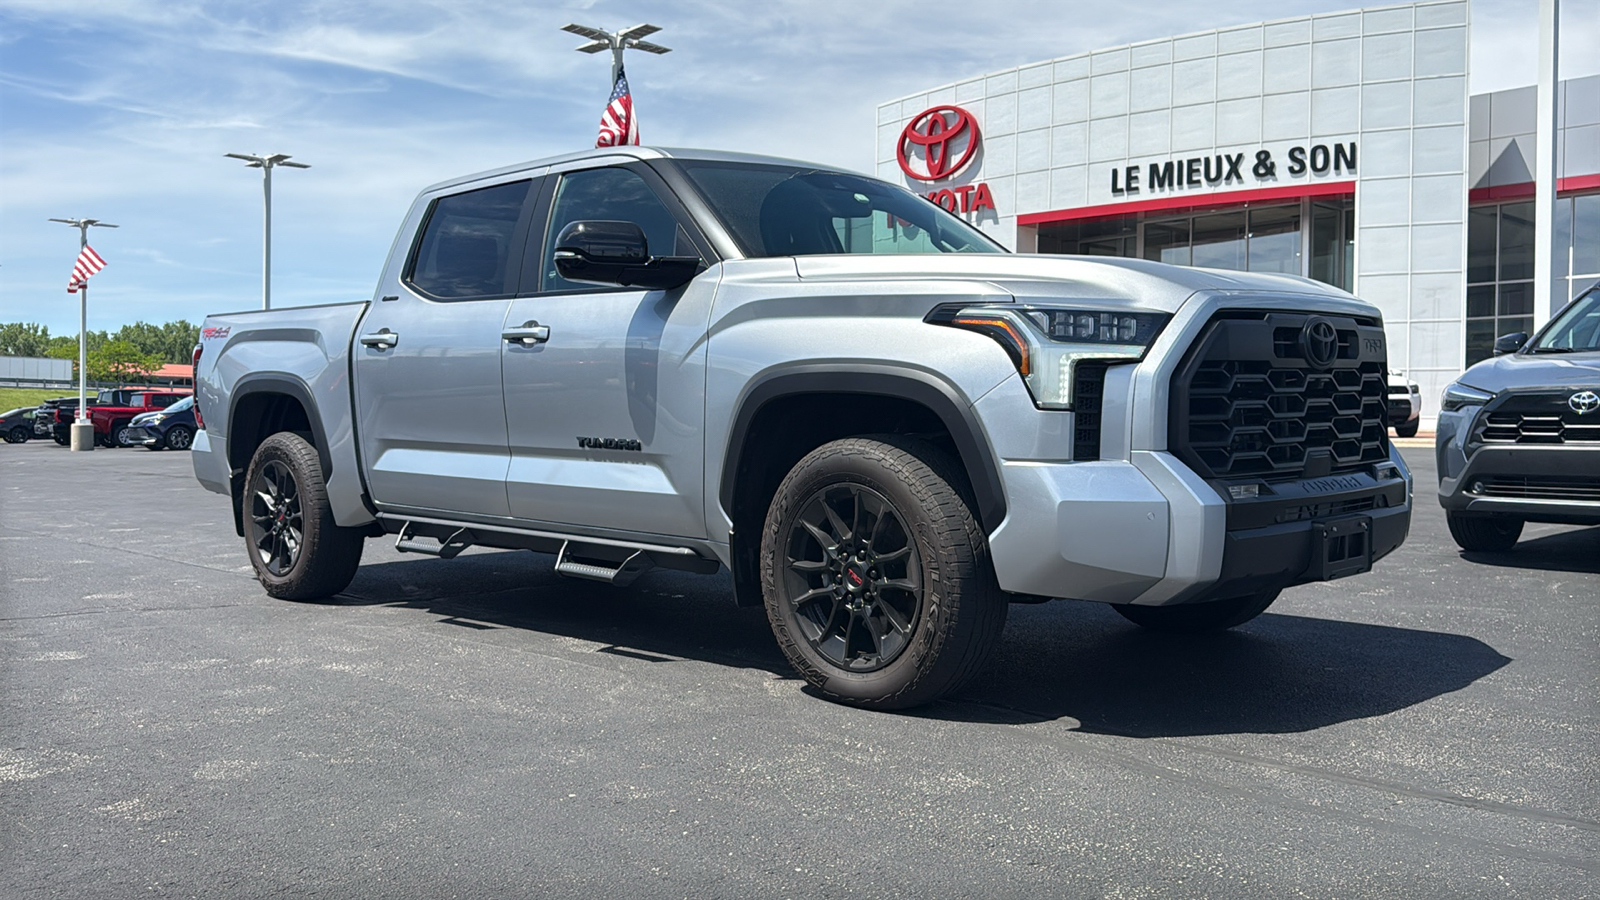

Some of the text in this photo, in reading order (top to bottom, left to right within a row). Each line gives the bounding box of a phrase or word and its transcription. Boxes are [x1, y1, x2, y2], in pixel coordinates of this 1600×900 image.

[1111, 142, 1356, 194] LE MIEUX & SON
[576, 436, 642, 451] TUNDRA
